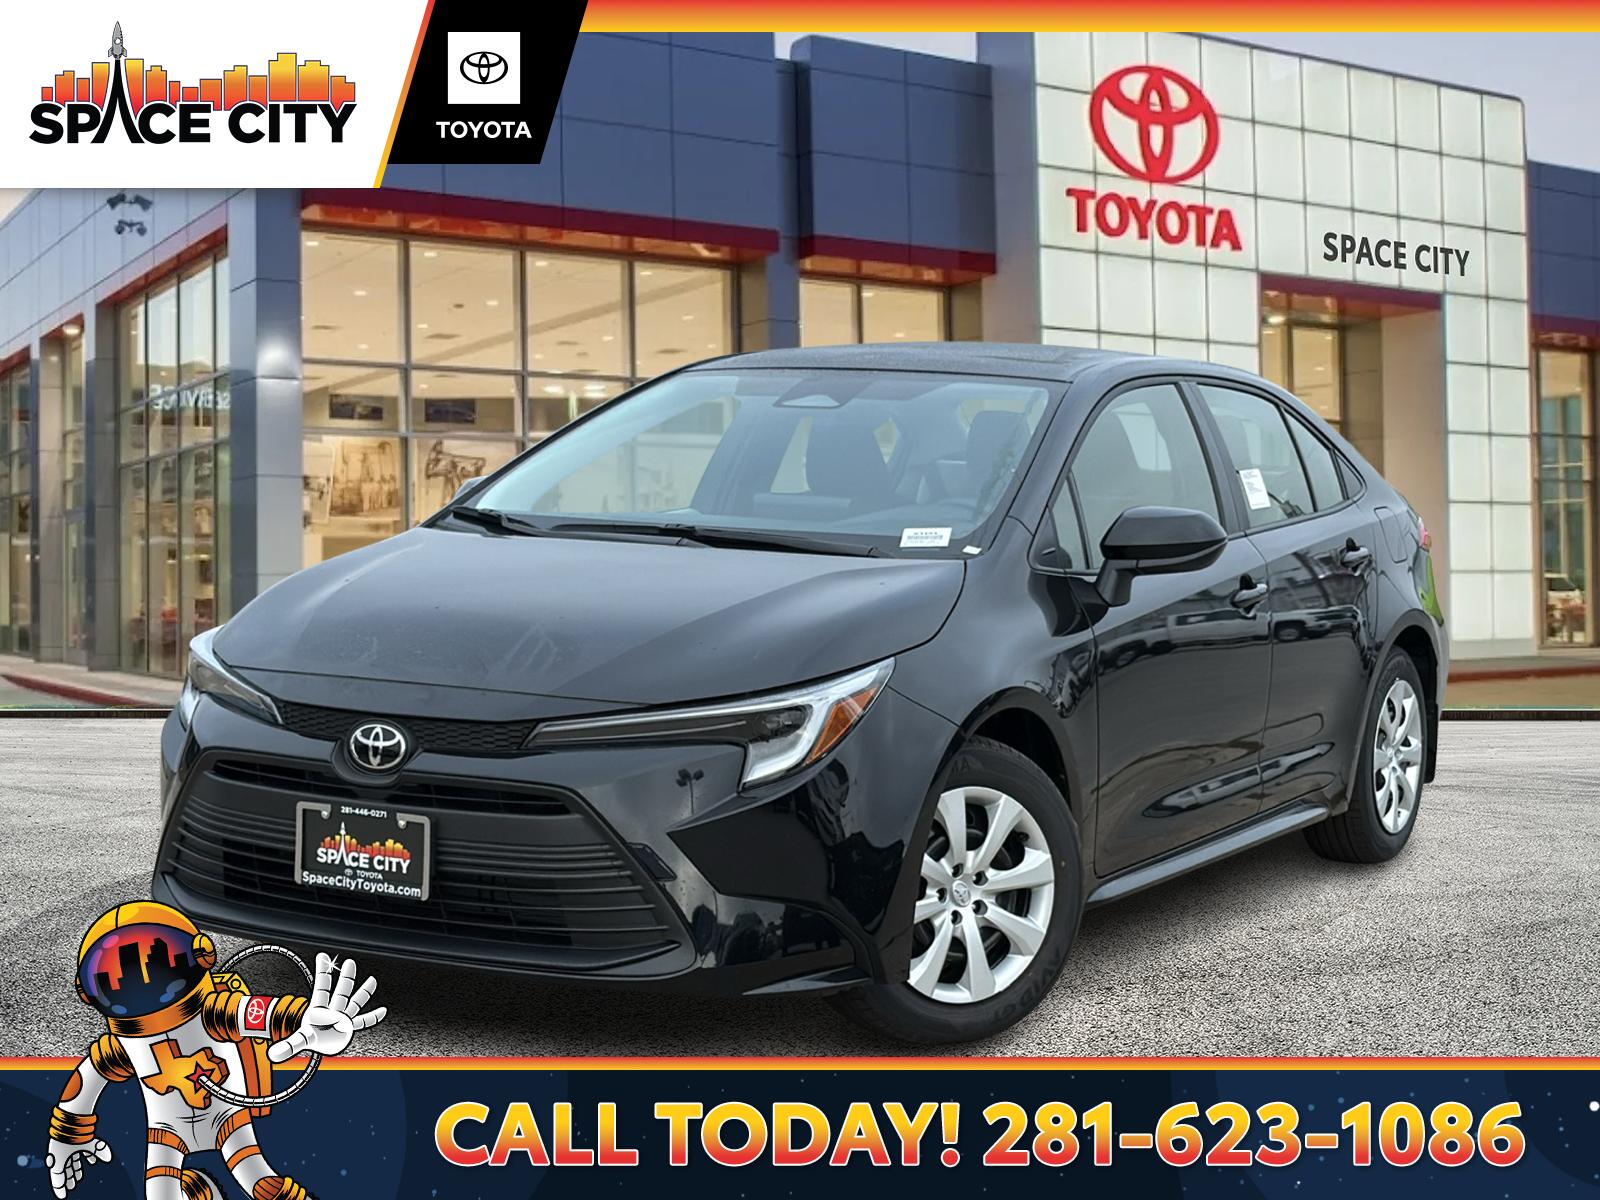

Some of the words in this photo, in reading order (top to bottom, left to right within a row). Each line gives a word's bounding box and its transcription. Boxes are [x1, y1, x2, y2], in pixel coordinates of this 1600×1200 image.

[1066, 187, 1242, 251] TOYOTA
[1323, 232, 1407, 270] SPACE
[1414, 244, 1470, 277] CITY
[340, 806, 387, 818] 281-446-0271
[316, 834, 369, 868] SPACE
[373, 855, 411, 874] CITY
[302, 870, 421, 898] SpaceCityToyota.com
[356, 869, 383, 880] TOYOTA
